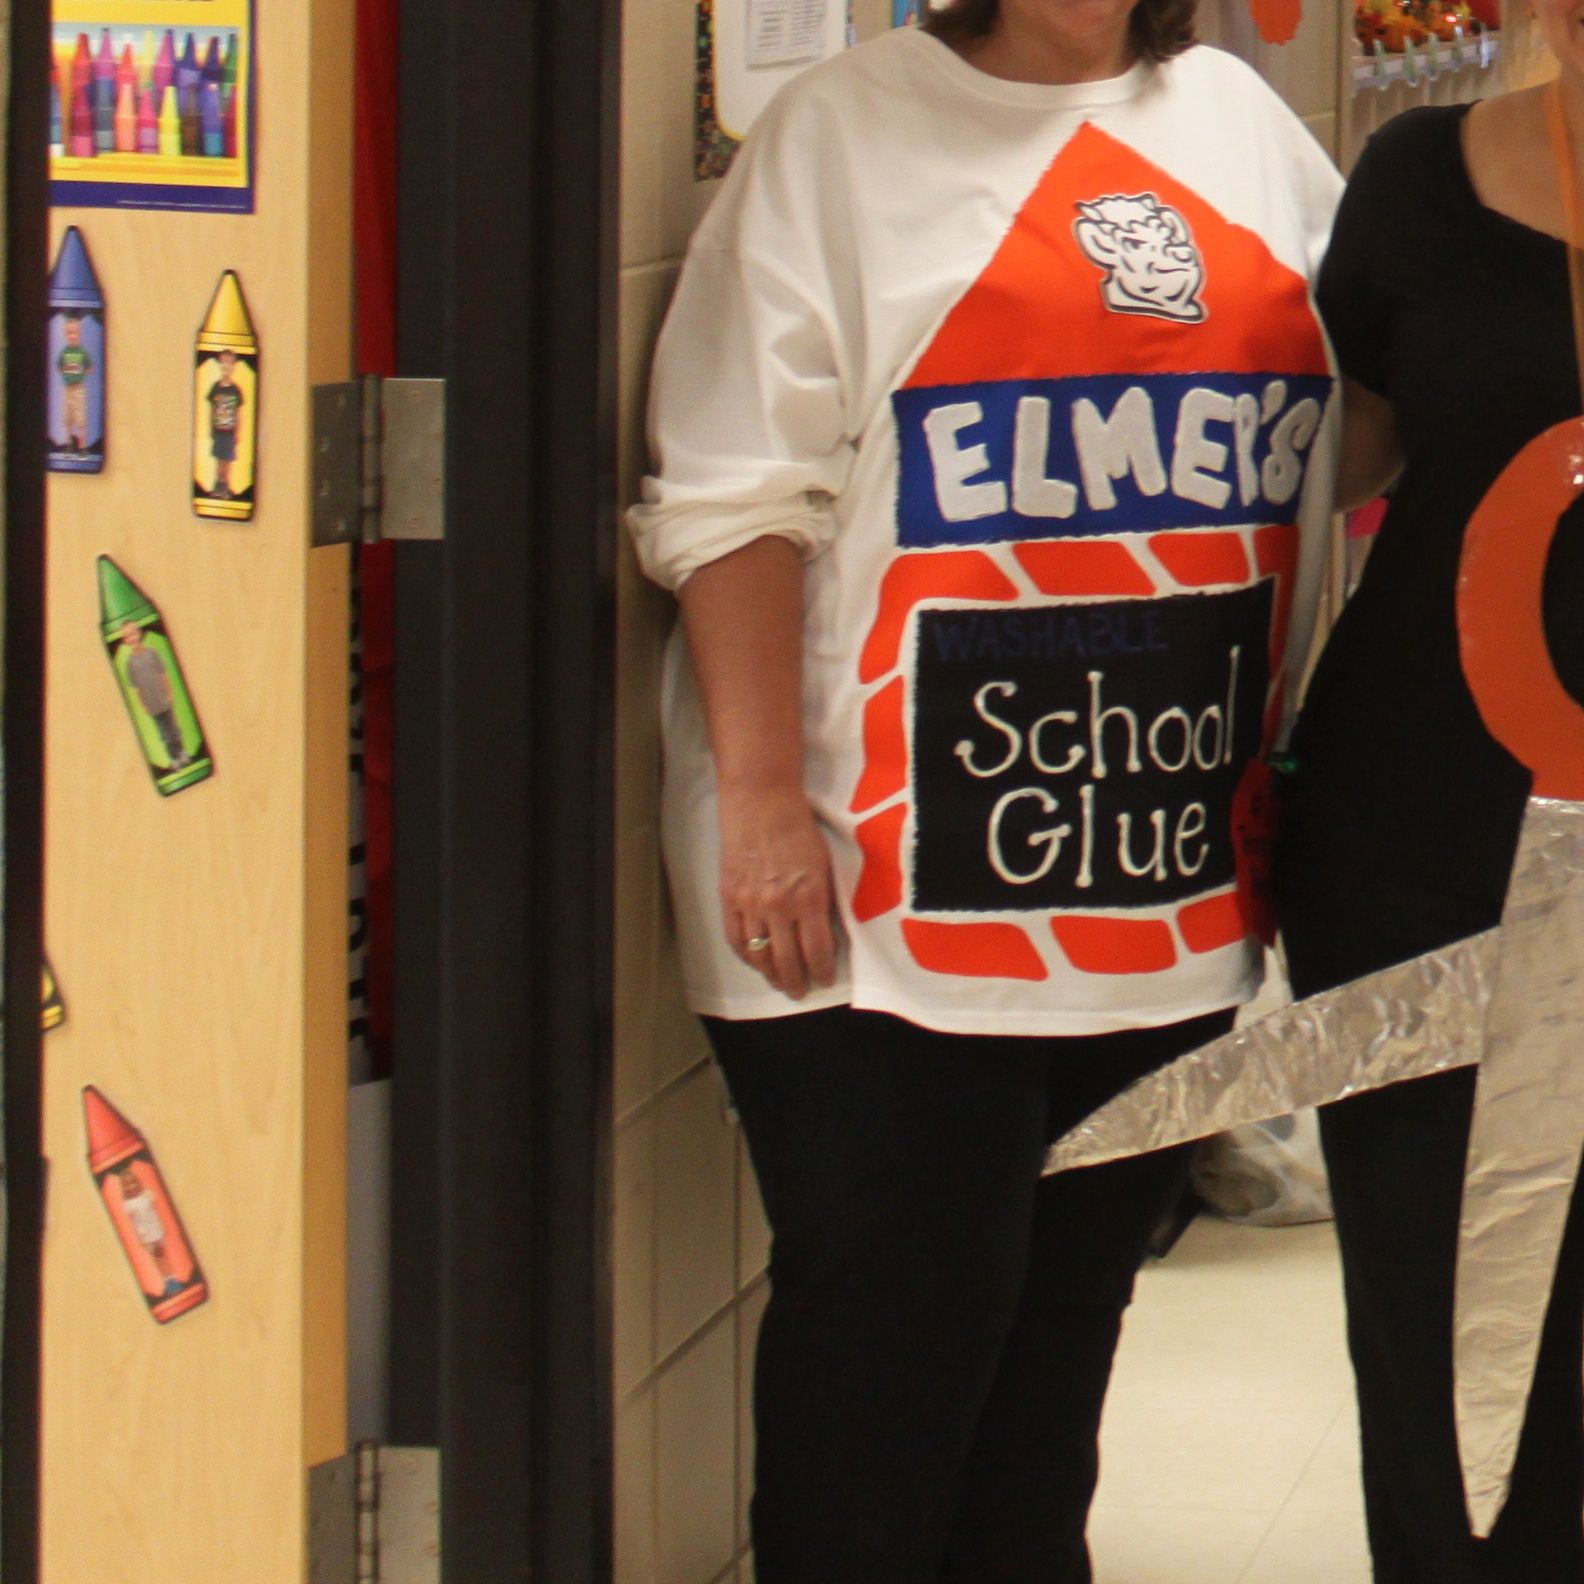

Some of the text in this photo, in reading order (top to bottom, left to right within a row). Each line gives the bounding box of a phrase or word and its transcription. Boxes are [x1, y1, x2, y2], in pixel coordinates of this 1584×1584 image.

[921, 381, 1321, 524] ELMER'S
[930, 606, 1170, 664] WASHABLE
[954, 645, 1242, 779] School
[987, 784, 1210, 889] Glue
